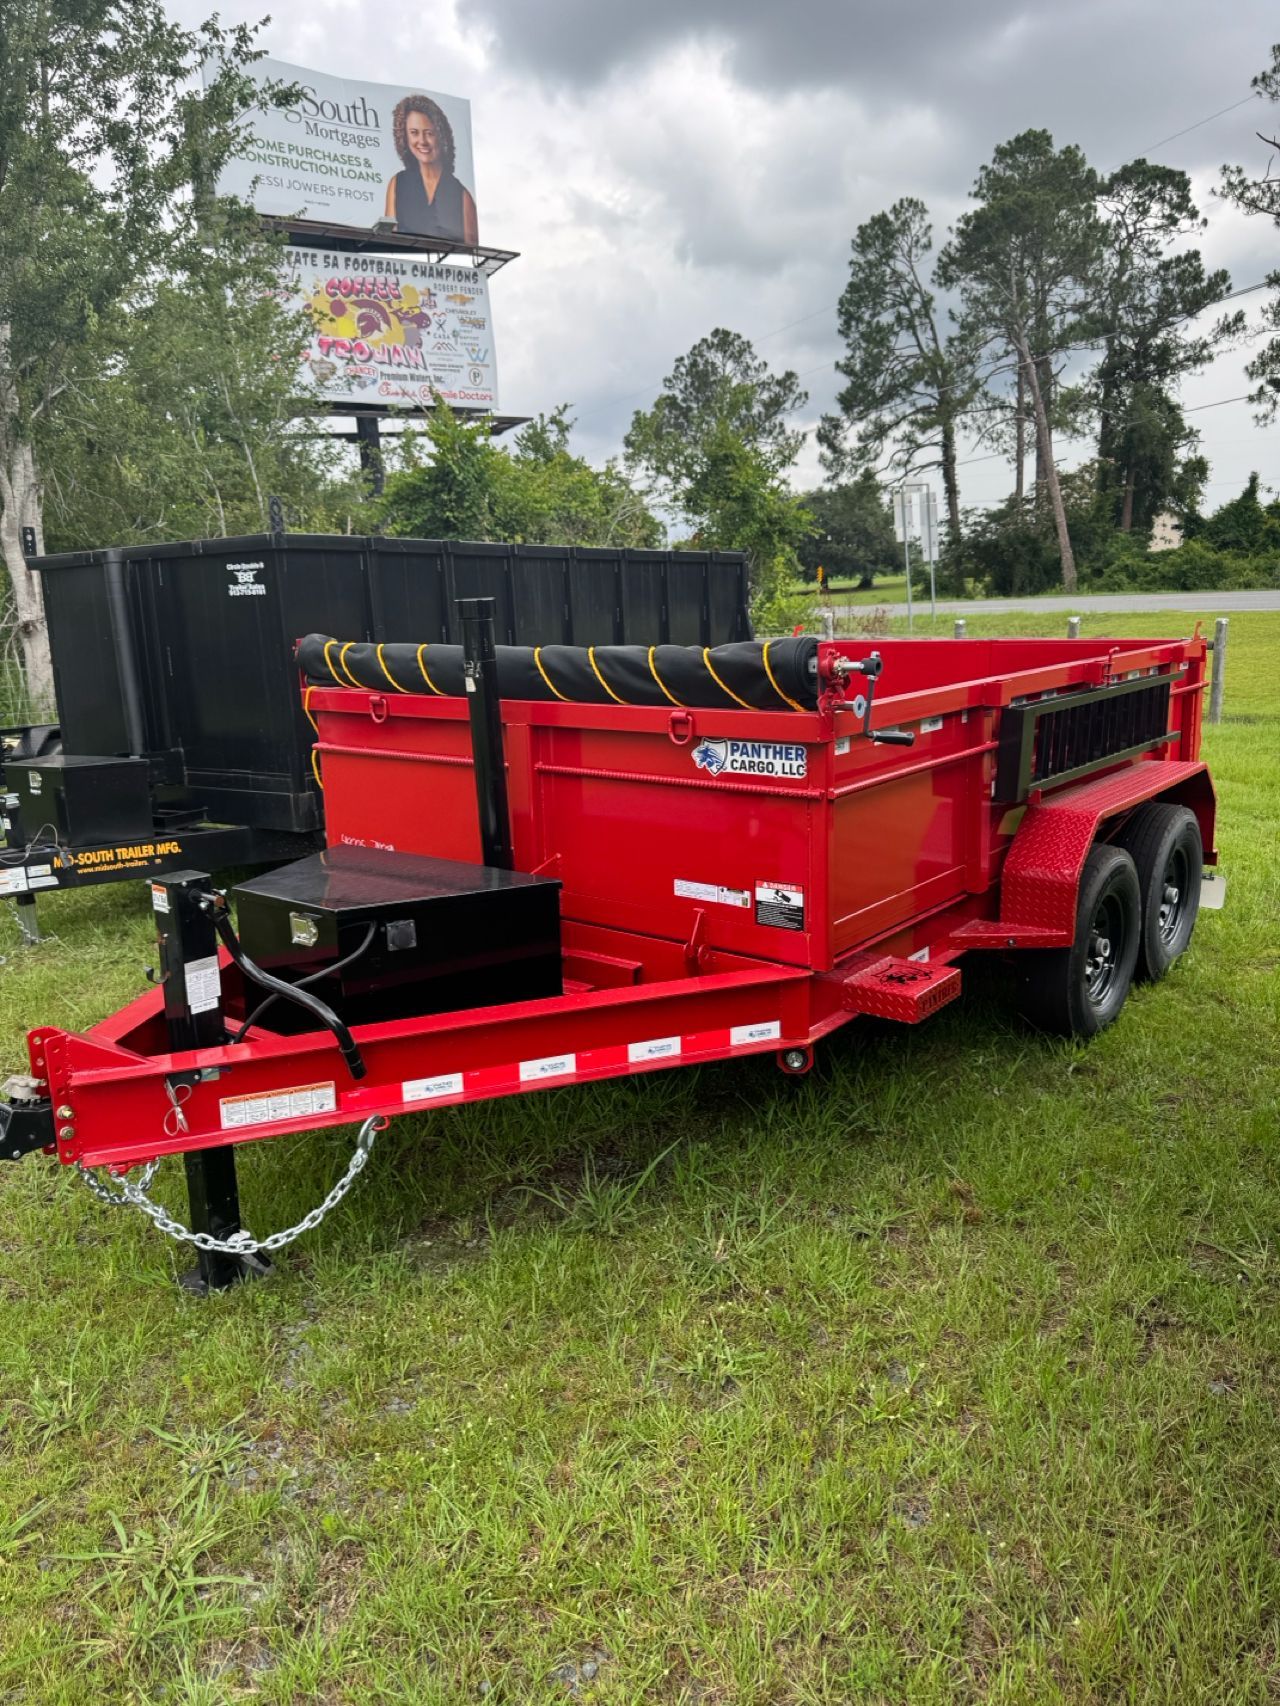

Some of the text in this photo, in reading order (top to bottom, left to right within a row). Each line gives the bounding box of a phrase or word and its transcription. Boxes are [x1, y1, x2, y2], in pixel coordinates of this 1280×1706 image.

[304, 120, 381, 149] Mortgages
[237, 150, 383, 184] CONSTRUCTION LOANS
[250, 138, 373, 169] OME PURCHASES &
[259, 174, 375, 202] ESSI JOWERS FROST
[344, 256, 408, 276] FOOTBALL
[411, 264, 479, 285] CHAMPIONS
[325, 276, 403, 300] COFFEE
[459, 391, 493, 401] Doctors
[729, 742, 805, 762] PANTHER
[730, 759, 805, 776] CARGO, LLC
[53, 842, 183, 868] MD-SOUTH TRAILER MFG.
